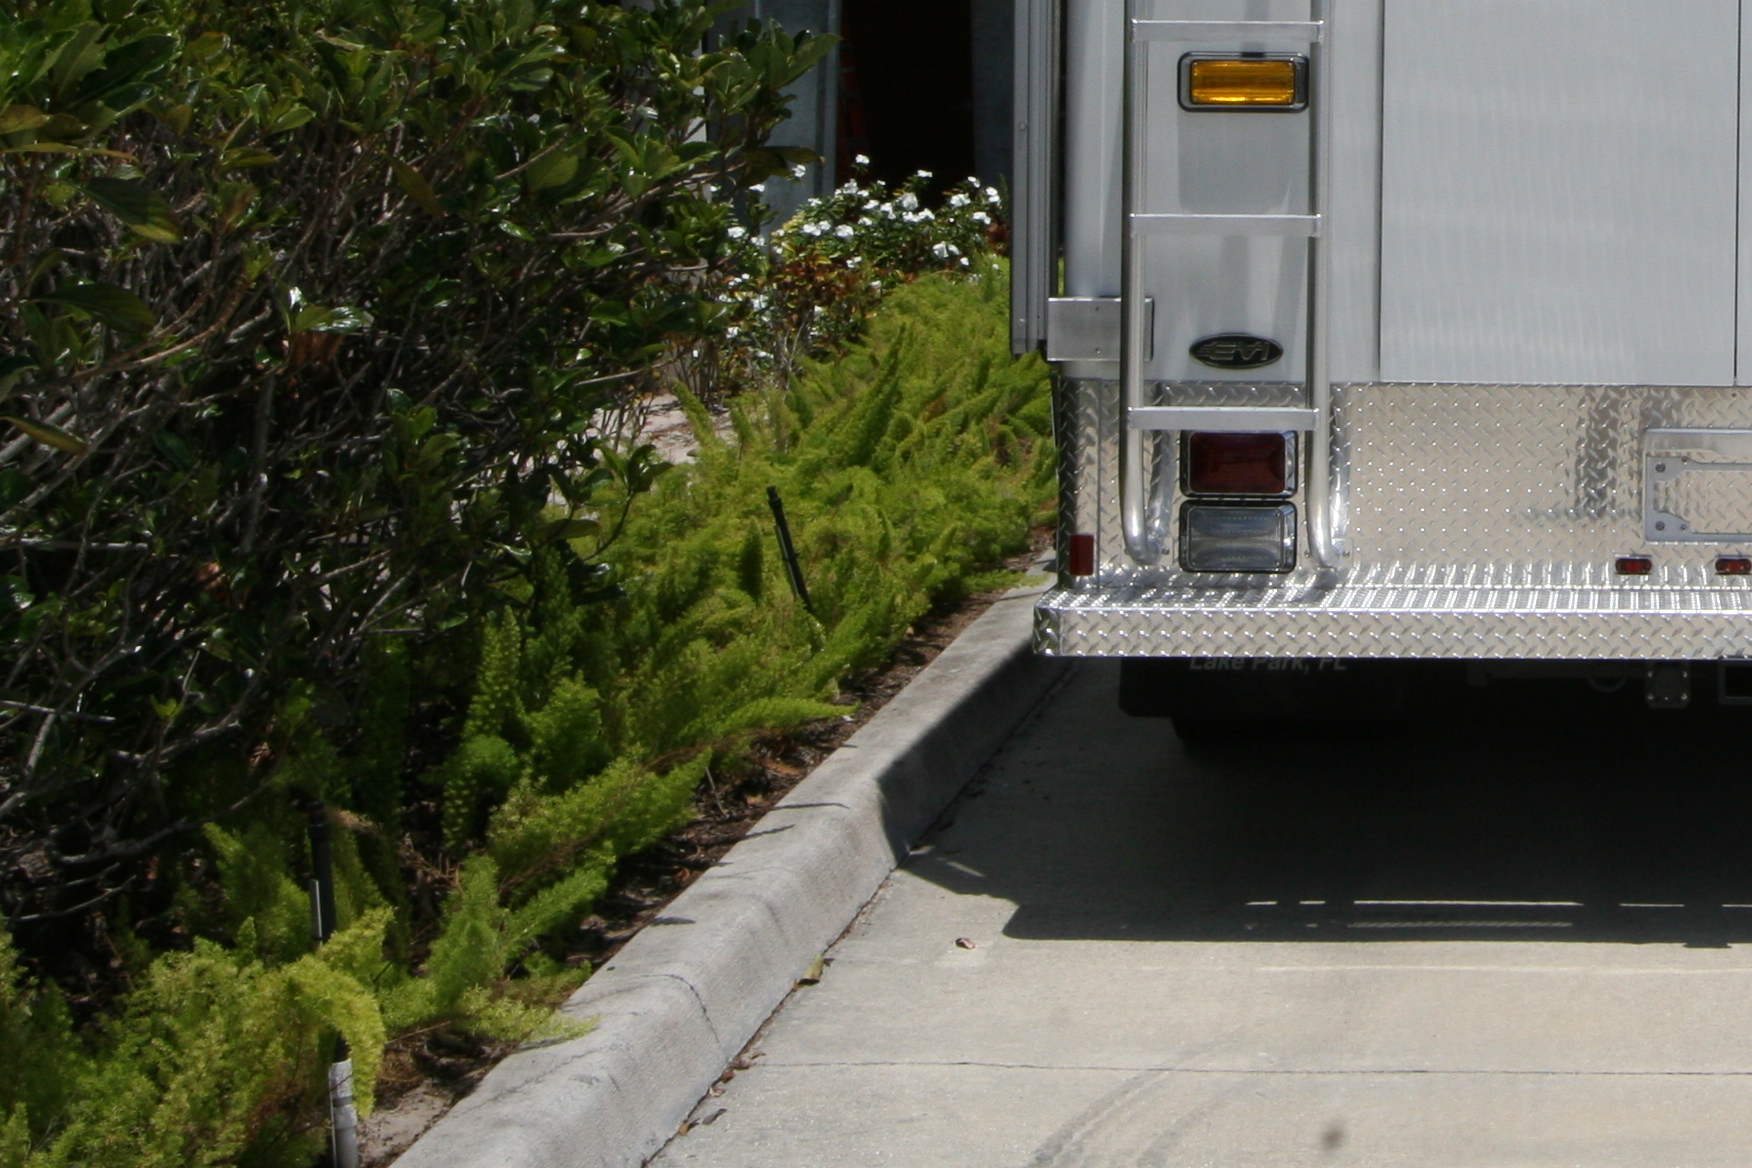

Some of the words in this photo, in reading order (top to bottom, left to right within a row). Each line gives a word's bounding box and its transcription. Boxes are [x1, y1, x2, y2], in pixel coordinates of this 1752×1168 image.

[1189, 657, 1245, 670] Lake
[1252, 657, 1309, 674] Park,
[1318, 658, 1348, 671] FL
